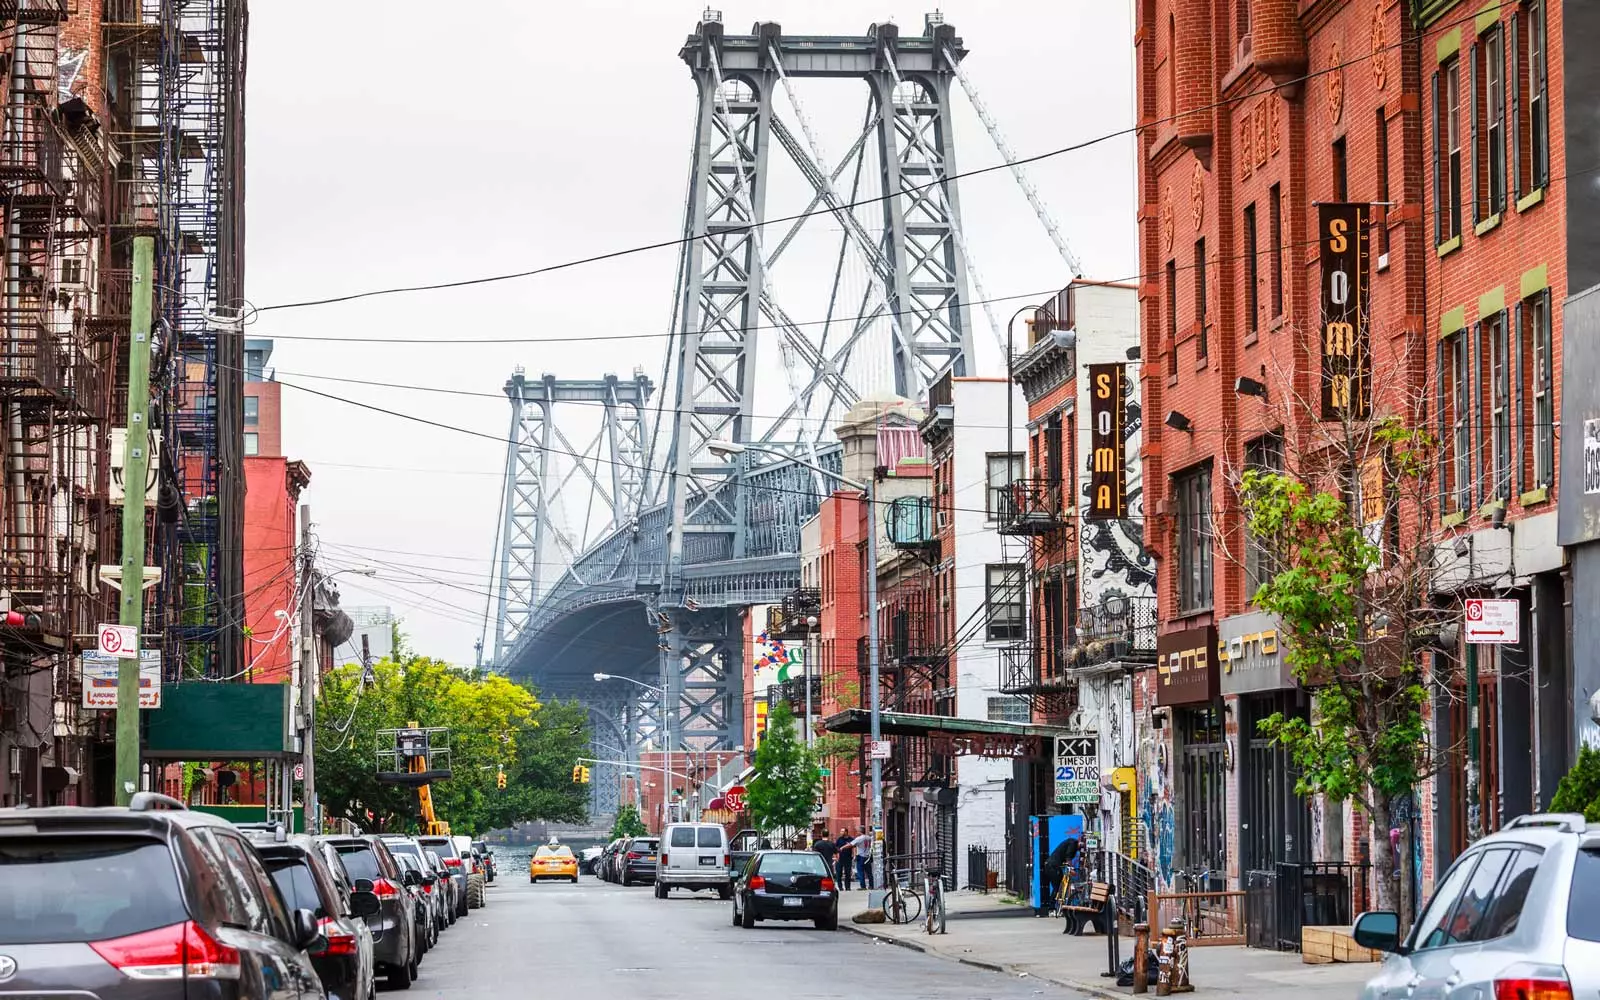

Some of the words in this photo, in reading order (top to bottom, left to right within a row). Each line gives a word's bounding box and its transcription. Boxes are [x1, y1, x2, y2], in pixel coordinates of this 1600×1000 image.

[1095, 373, 1114, 509] SOMA
[1056, 766, 1074, 780] 25
[1073, 766, 1099, 780] YEARS
[1061, 787, 1092, 795] EDUCATION
[727, 793, 743, 804] STO
